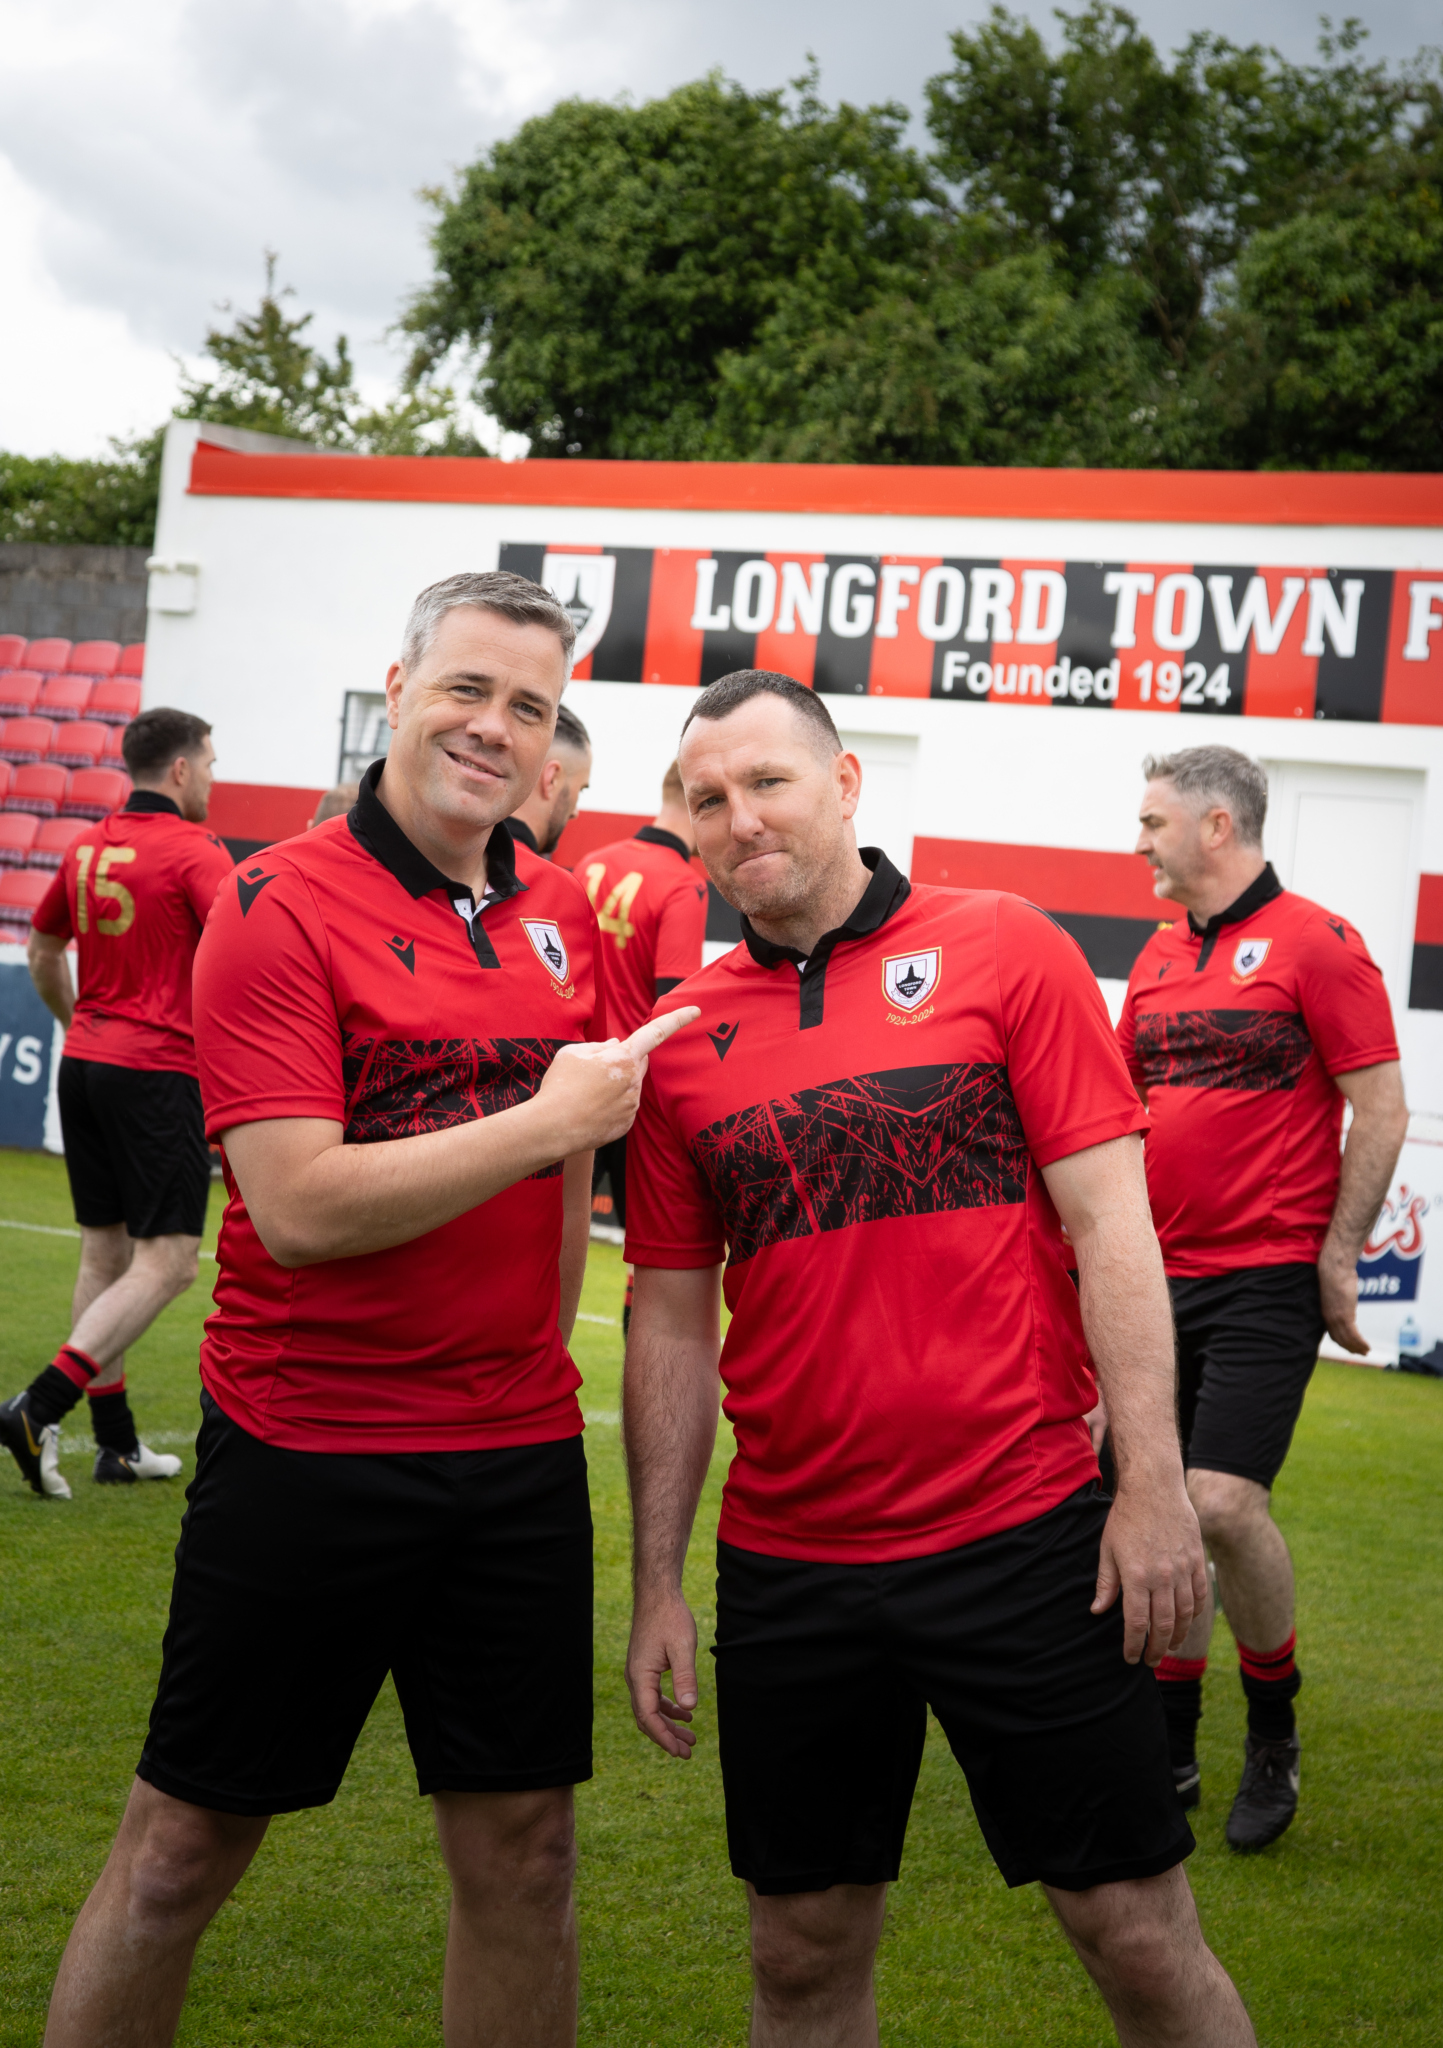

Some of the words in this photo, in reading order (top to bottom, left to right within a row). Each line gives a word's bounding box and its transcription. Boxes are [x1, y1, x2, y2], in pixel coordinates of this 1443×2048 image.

[690, 558, 1068, 644] LONGFORD
[1103, 570, 1365, 659] TOWN
[1403, 579, 1443, 661] F
[941, 650, 1121, 702] Founded
[1133, 659, 1232, 706] 1924
[75, 844, 137, 937] 15
[585, 862, 644, 950] 14
[885, 1004, 935, 1026] 1924-2024
